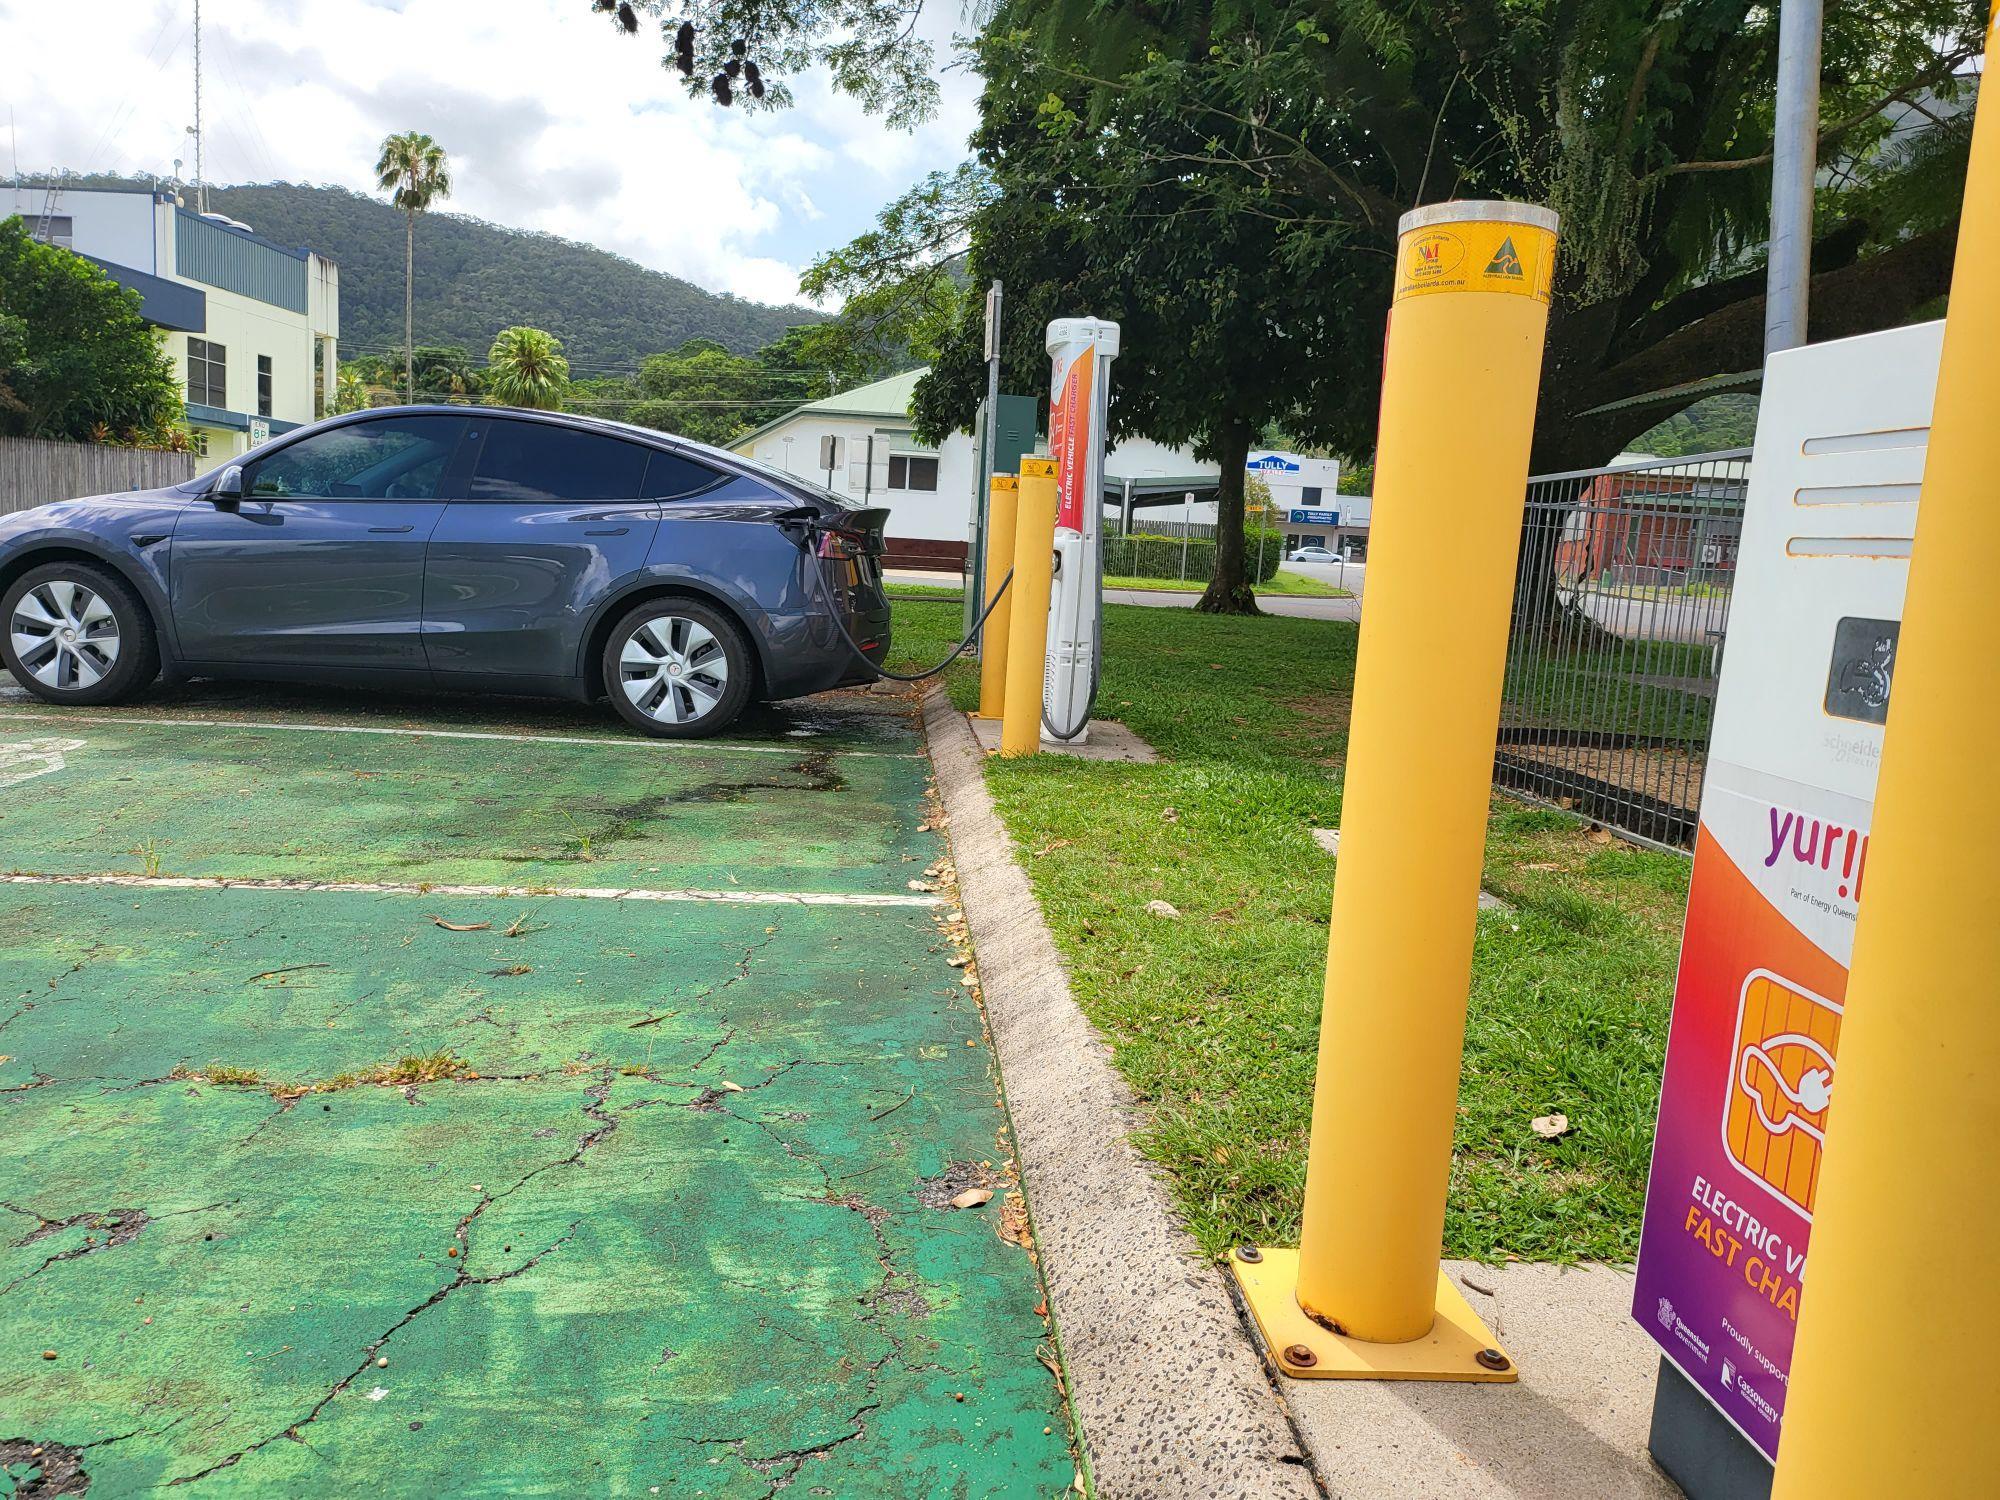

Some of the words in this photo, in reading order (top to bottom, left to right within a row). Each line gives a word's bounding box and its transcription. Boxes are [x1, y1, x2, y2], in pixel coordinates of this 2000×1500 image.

[1070, 374, 1078, 413] CHARGER
[254, 429, 266, 439] 8P
[1068, 415, 1076, 436] FAST
[1066, 437, 1075, 470] VEHICLE
[1259, 461, 1288, 470] TULLY
[1065, 473, 1073, 509] ELECTRIC
[1791, 888, 1802, 899] Part
[1803, 894, 1810, 903] of
[1811, 898, 1831, 913] Energy
[1691, 1175, 1782, 1260] ELECTRIC
[1685, 1205, 1743, 1267] FAST
[1745, 1256, 1798, 1320] CHA
[1674, 1326, 1708, 1364] Government
[1676, 1317, 1710, 1355] Queensland
[1721, 1317, 1754, 1355] Proudly
[1754, 1349, 1789, 1387] support
[1737, 1375, 1778, 1423] Cassowary
